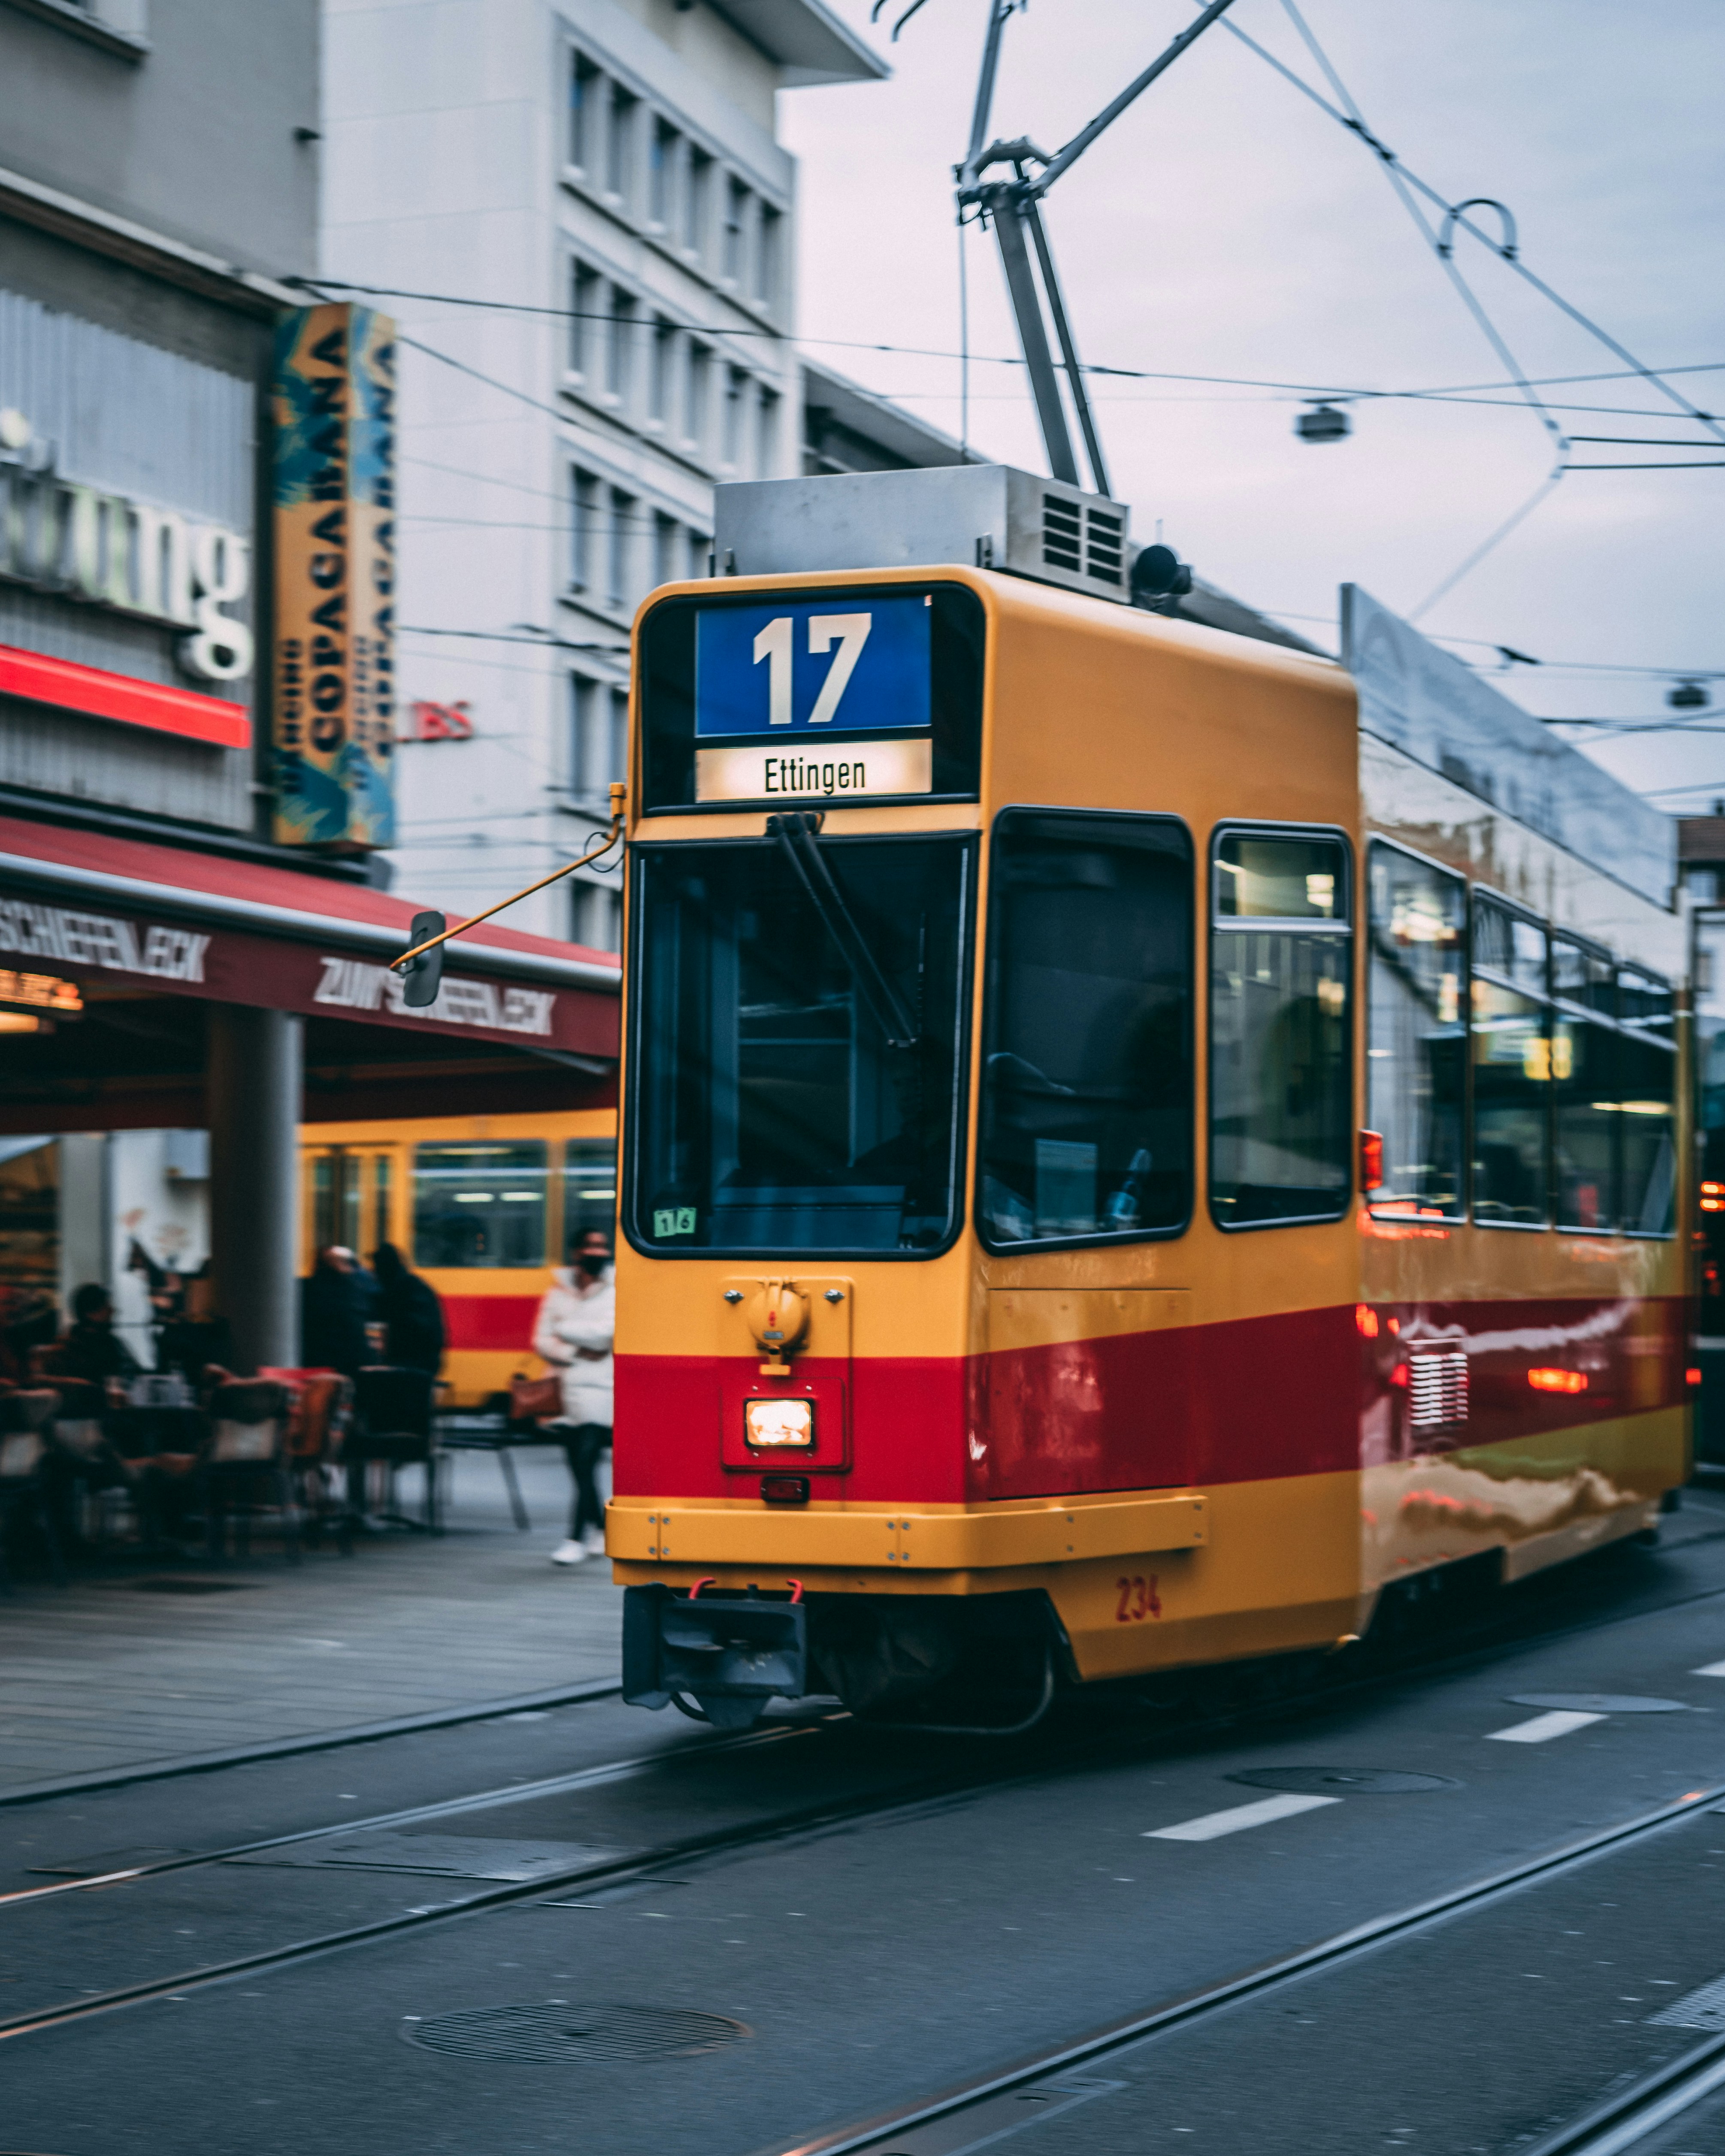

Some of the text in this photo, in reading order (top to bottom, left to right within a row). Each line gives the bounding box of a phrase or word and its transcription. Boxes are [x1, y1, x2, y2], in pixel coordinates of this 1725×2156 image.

[310, 328, 346, 754] COPACABANA
[753, 613, 872, 725] 17
[765, 757, 866, 796] Ettingen
[142, 924, 212, 984] ECK
[313, 957, 390, 1011] ZUM
[661, 1214, 690, 1233] 16
[1116, 1574, 1162, 1622] 234
